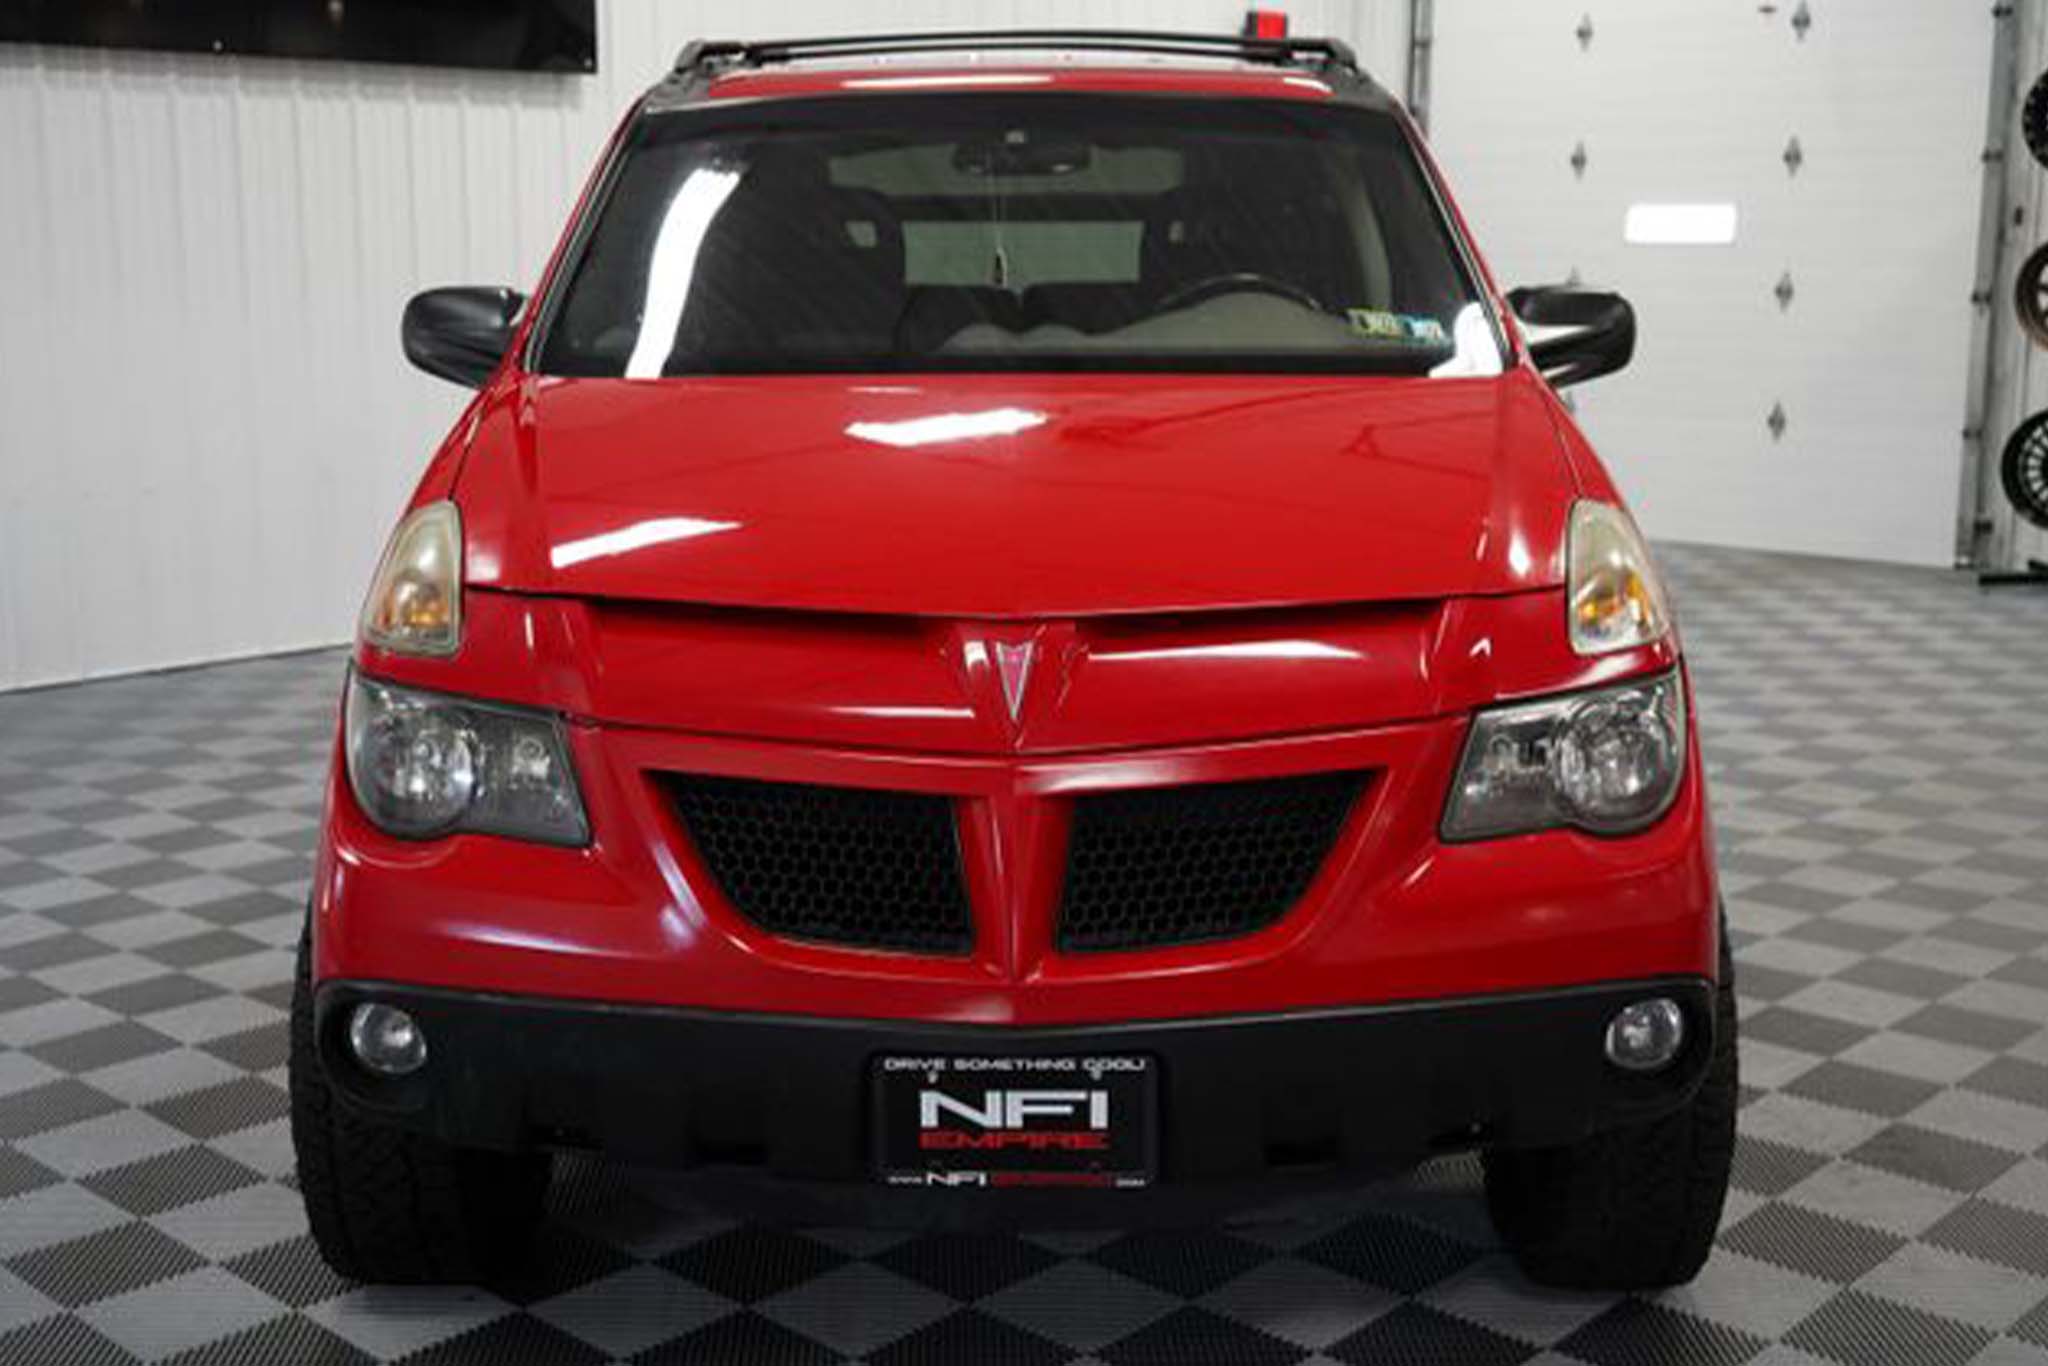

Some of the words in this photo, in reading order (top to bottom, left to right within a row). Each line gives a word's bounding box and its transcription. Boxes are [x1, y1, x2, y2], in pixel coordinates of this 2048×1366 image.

[885, 1057, 946, 1071] DRIVE
[953, 1057, 1076, 1071] SOMETHING
[919, 1089, 1109, 1129] NFI
[918, 1131, 1110, 1150] EMPIRE
